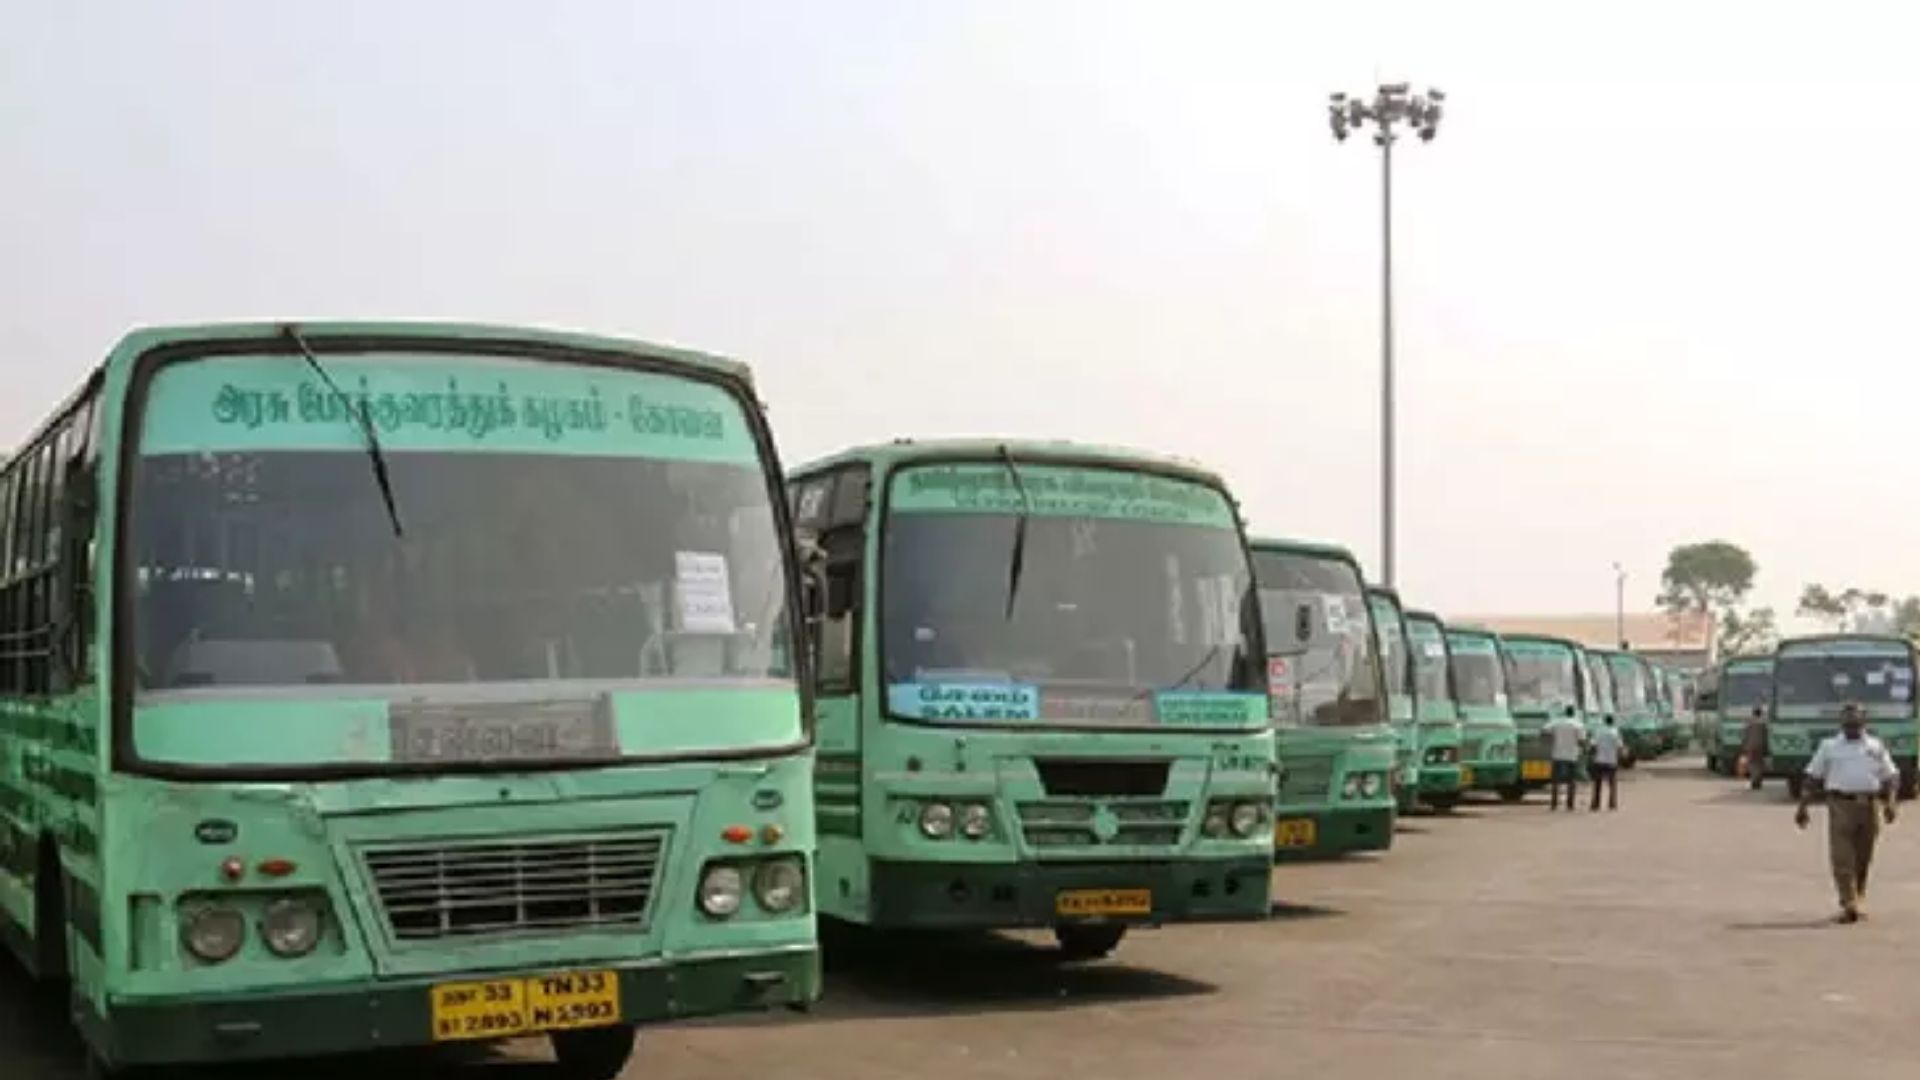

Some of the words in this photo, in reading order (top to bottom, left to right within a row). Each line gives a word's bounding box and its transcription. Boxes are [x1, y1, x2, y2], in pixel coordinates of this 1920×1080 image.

[213, 382, 289, 430] அரசு
[920, 704, 1031, 720] SALEM
[540, 977, 572, 995] TN
[578, 973, 606, 993] 33
